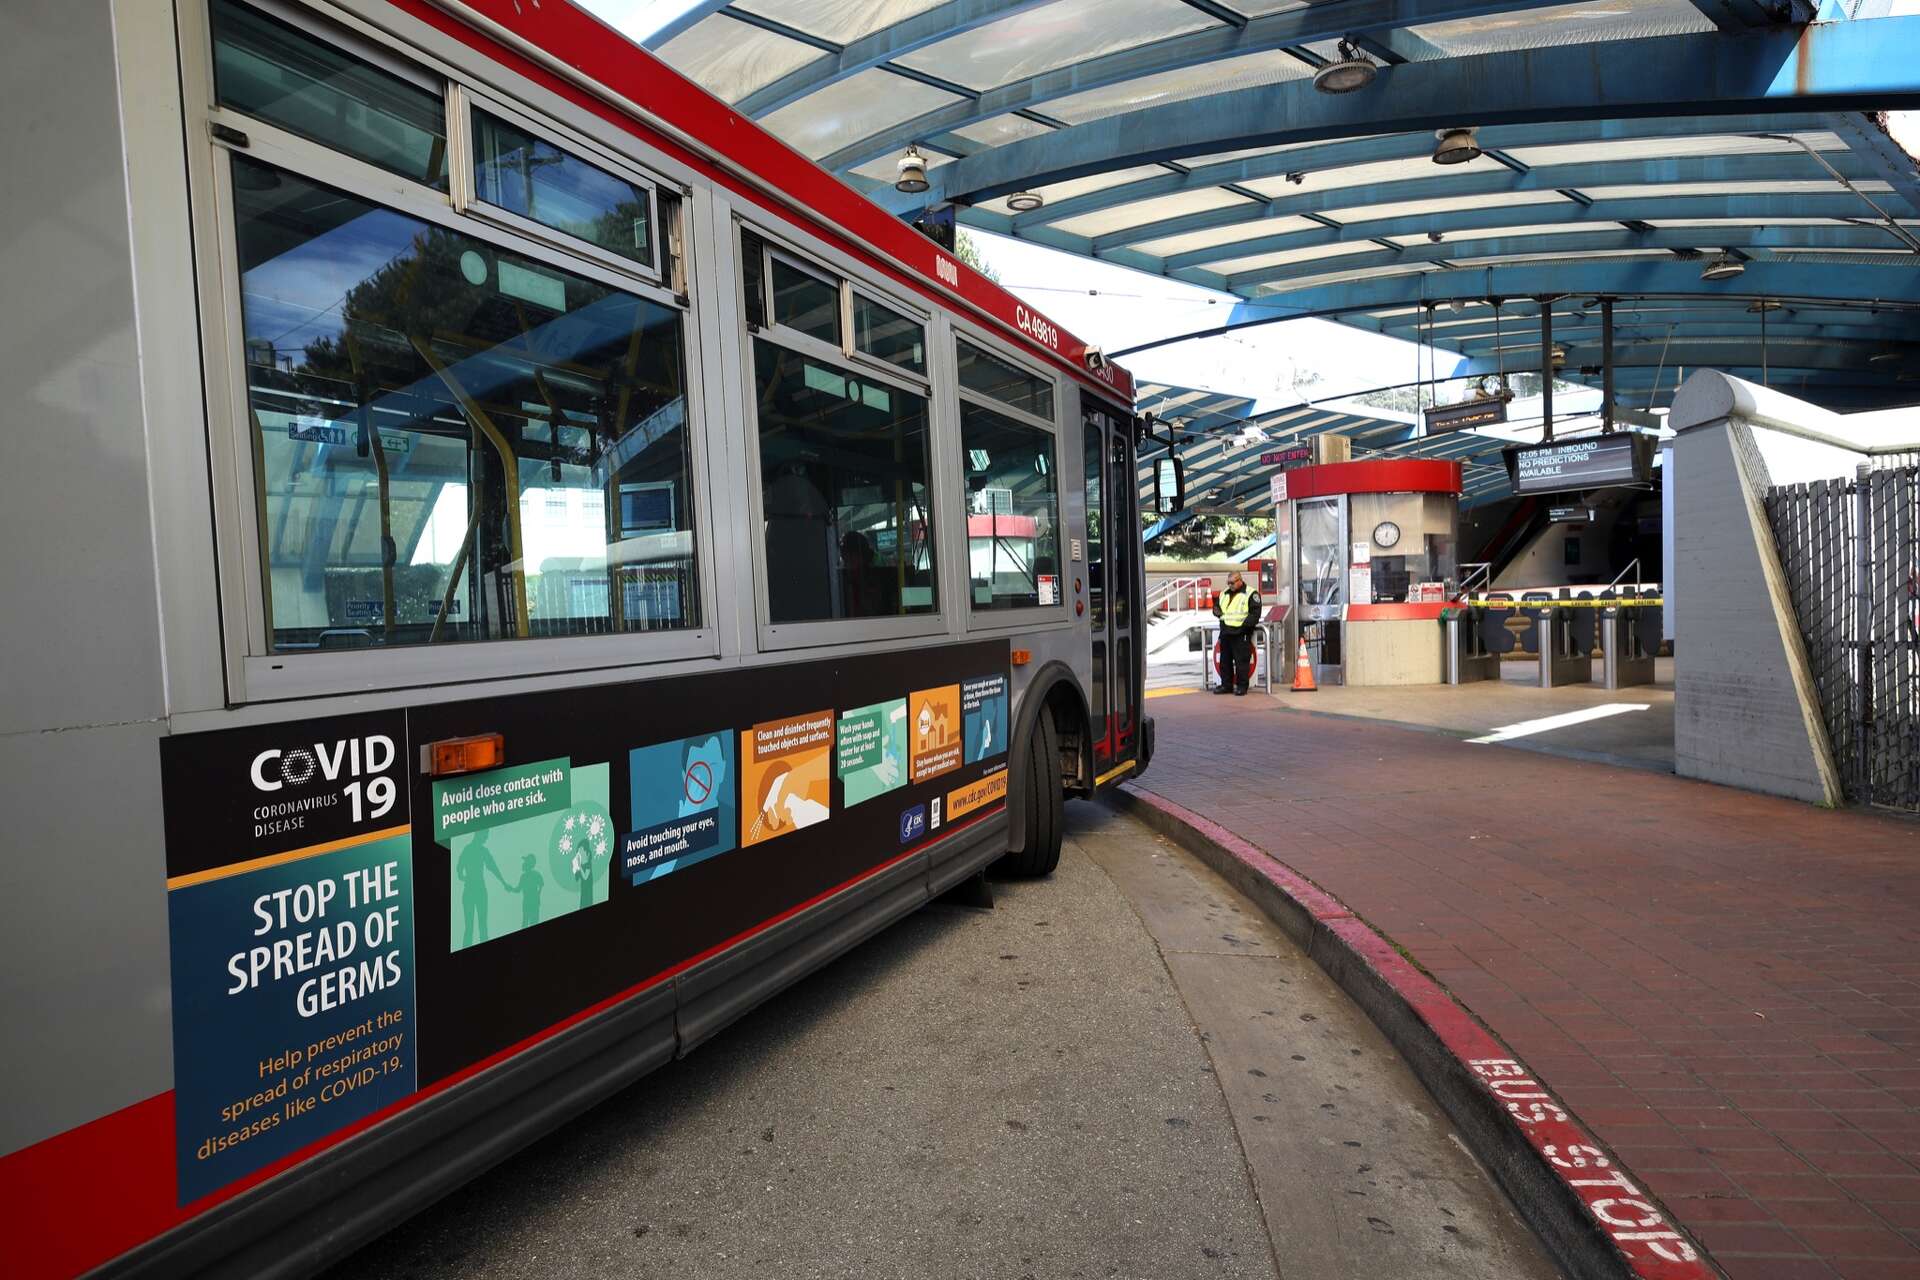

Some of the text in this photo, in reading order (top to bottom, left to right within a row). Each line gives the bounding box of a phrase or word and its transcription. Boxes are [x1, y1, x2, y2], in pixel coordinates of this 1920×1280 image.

[1017, 305, 1057, 349] CA 49819
[1518, 441, 1597, 459] 12:05 PM INBOUND
[1519, 453, 1589, 469] NO PREDICTIONS
[1520, 466, 1561, 478] AVAILABLE
[757, 716, 831, 741] Clean and disinfect frequently
[757, 730, 829, 754] touched objects and surfaces.
[872, 728, 880, 738] and
[250, 734, 395, 791] COVID
[253, 776, 397, 823] CORONAVIRUS 19
[441, 769, 563, 807] Avoid close contact with
[255, 816, 305, 838] DISEASE
[442, 790, 546, 829] people who are sick.
[626, 817, 715, 853] Avoid touching your eyes,
[627, 837, 690, 868] nose, and mouth.
[253, 861, 399, 936] STOP THE
[227, 905, 399, 995] SPREAD OF
[296, 950, 401, 1018] GERMS
[258, 1009, 403, 1078] Help prevent the
[221, 1033, 403, 1122] spread of respiratory
[197, 1055, 403, 1160] diseases like COVID-19.
[1468, 1059, 1698, 1262] BUS STOP
